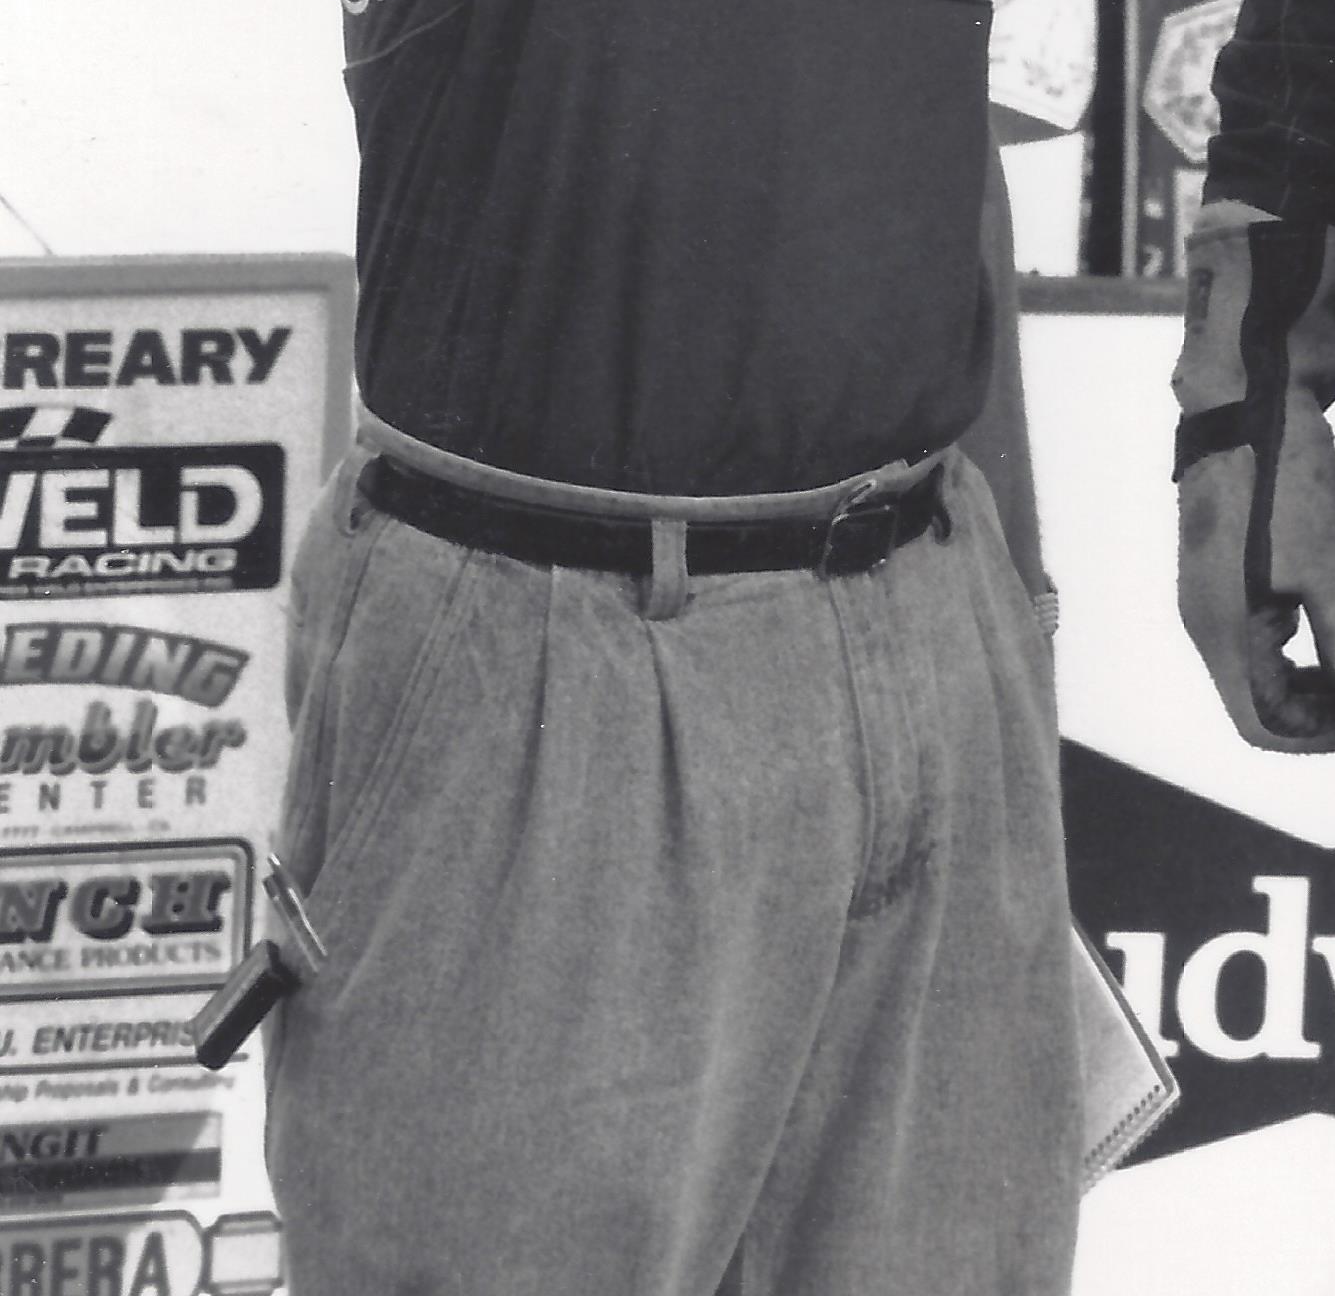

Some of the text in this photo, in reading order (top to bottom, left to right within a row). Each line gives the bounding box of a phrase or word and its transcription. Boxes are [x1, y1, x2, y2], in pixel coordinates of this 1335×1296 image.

[2, 325, 293, 390] REARY
[8, 547, 239, 580] RACING
[32, 1019, 198, 1056] ENTERPRIS
